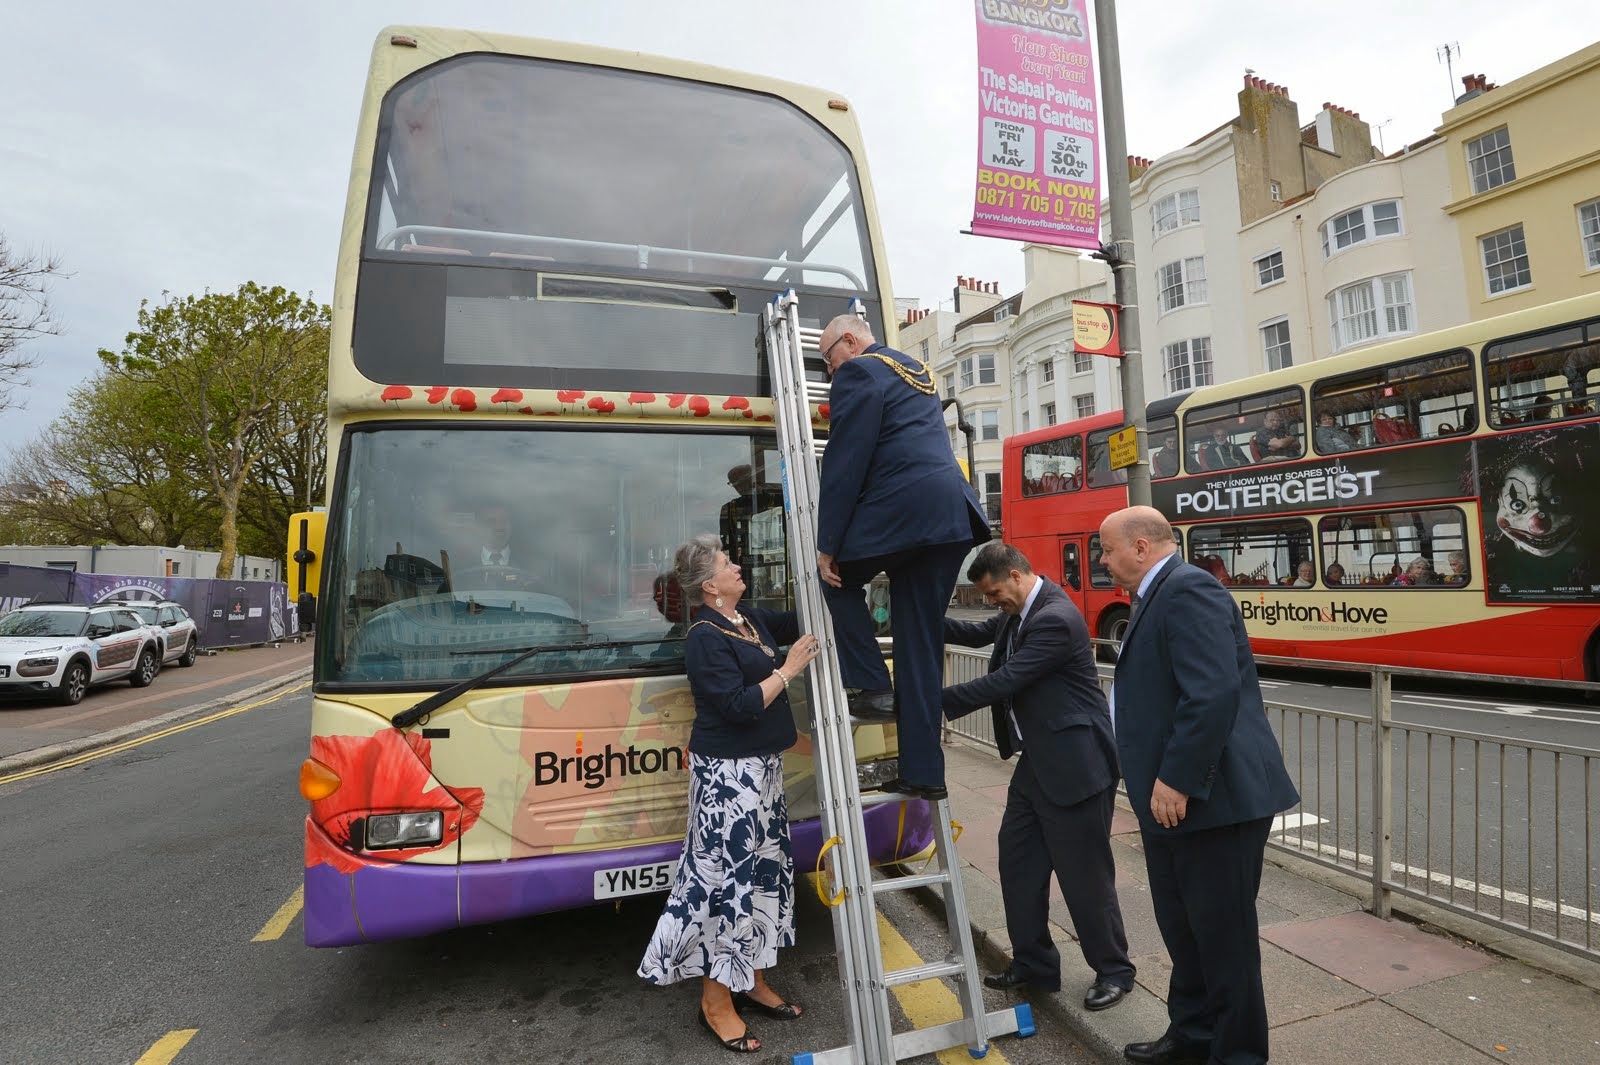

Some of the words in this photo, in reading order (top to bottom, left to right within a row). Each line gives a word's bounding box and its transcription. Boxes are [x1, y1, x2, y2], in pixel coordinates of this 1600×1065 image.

[985, 0, 1078, 34] BANGKOK
[1012, 34, 1046, 58] New
[1050, 44, 1089, 67] Show
[1021, 56, 1053, 80] Every
[1055, 64, 1086, 84] Year!
[980, 67, 1006, 91] The
[1008, 74, 1044, 100] Sabai
[1047, 83, 1093, 112] Pavilion
[980, 90, 1036, 121] Victoria
[1039, 104, 1094, 134] Gardens
[994, 121, 1024, 133] FROM
[998, 130, 1020, 142] FRI
[1000, 142, 1019, 157] 1st
[1056, 142, 1081, 154] SAT
[1062, 136, 1076, 144] TO
[992, 154, 1025, 167] MAY
[1051, 151, 1088, 169] 30th
[1053, 166, 1085, 178] MAY
[978, 169, 1041, 193] BOOK
[1048, 181, 1096, 201] NOW
[977, 187, 1015, 208] 0871
[1021, 194, 1050, 214] 705
[1054, 199, 1064, 215] 0
[1069, 201, 1096, 220] 705
[976, 212, 1095, 234] www.ladyboysofbangkok.co.uk
[1087, 320, 1100, 328] stop
[1206, 481, 1228, 490] THEY
[1229, 477, 1256, 488] KNOW
[1257, 474, 1283, 484] WHAT
[1284, 469, 1323, 480] SCARES
[1324, 465, 1348, 475] YOU.
[1176, 470, 1380, 514] POLTERGEIST
[93, 585, 111, 599] THE
[115, 579, 132, 588] OLD
[137, 579, 167, 595] STEINE
[1302, 624, 1329, 632] essential
[1375, 626, 1387, 634] city
[605, 864, 670, 892] YN55
